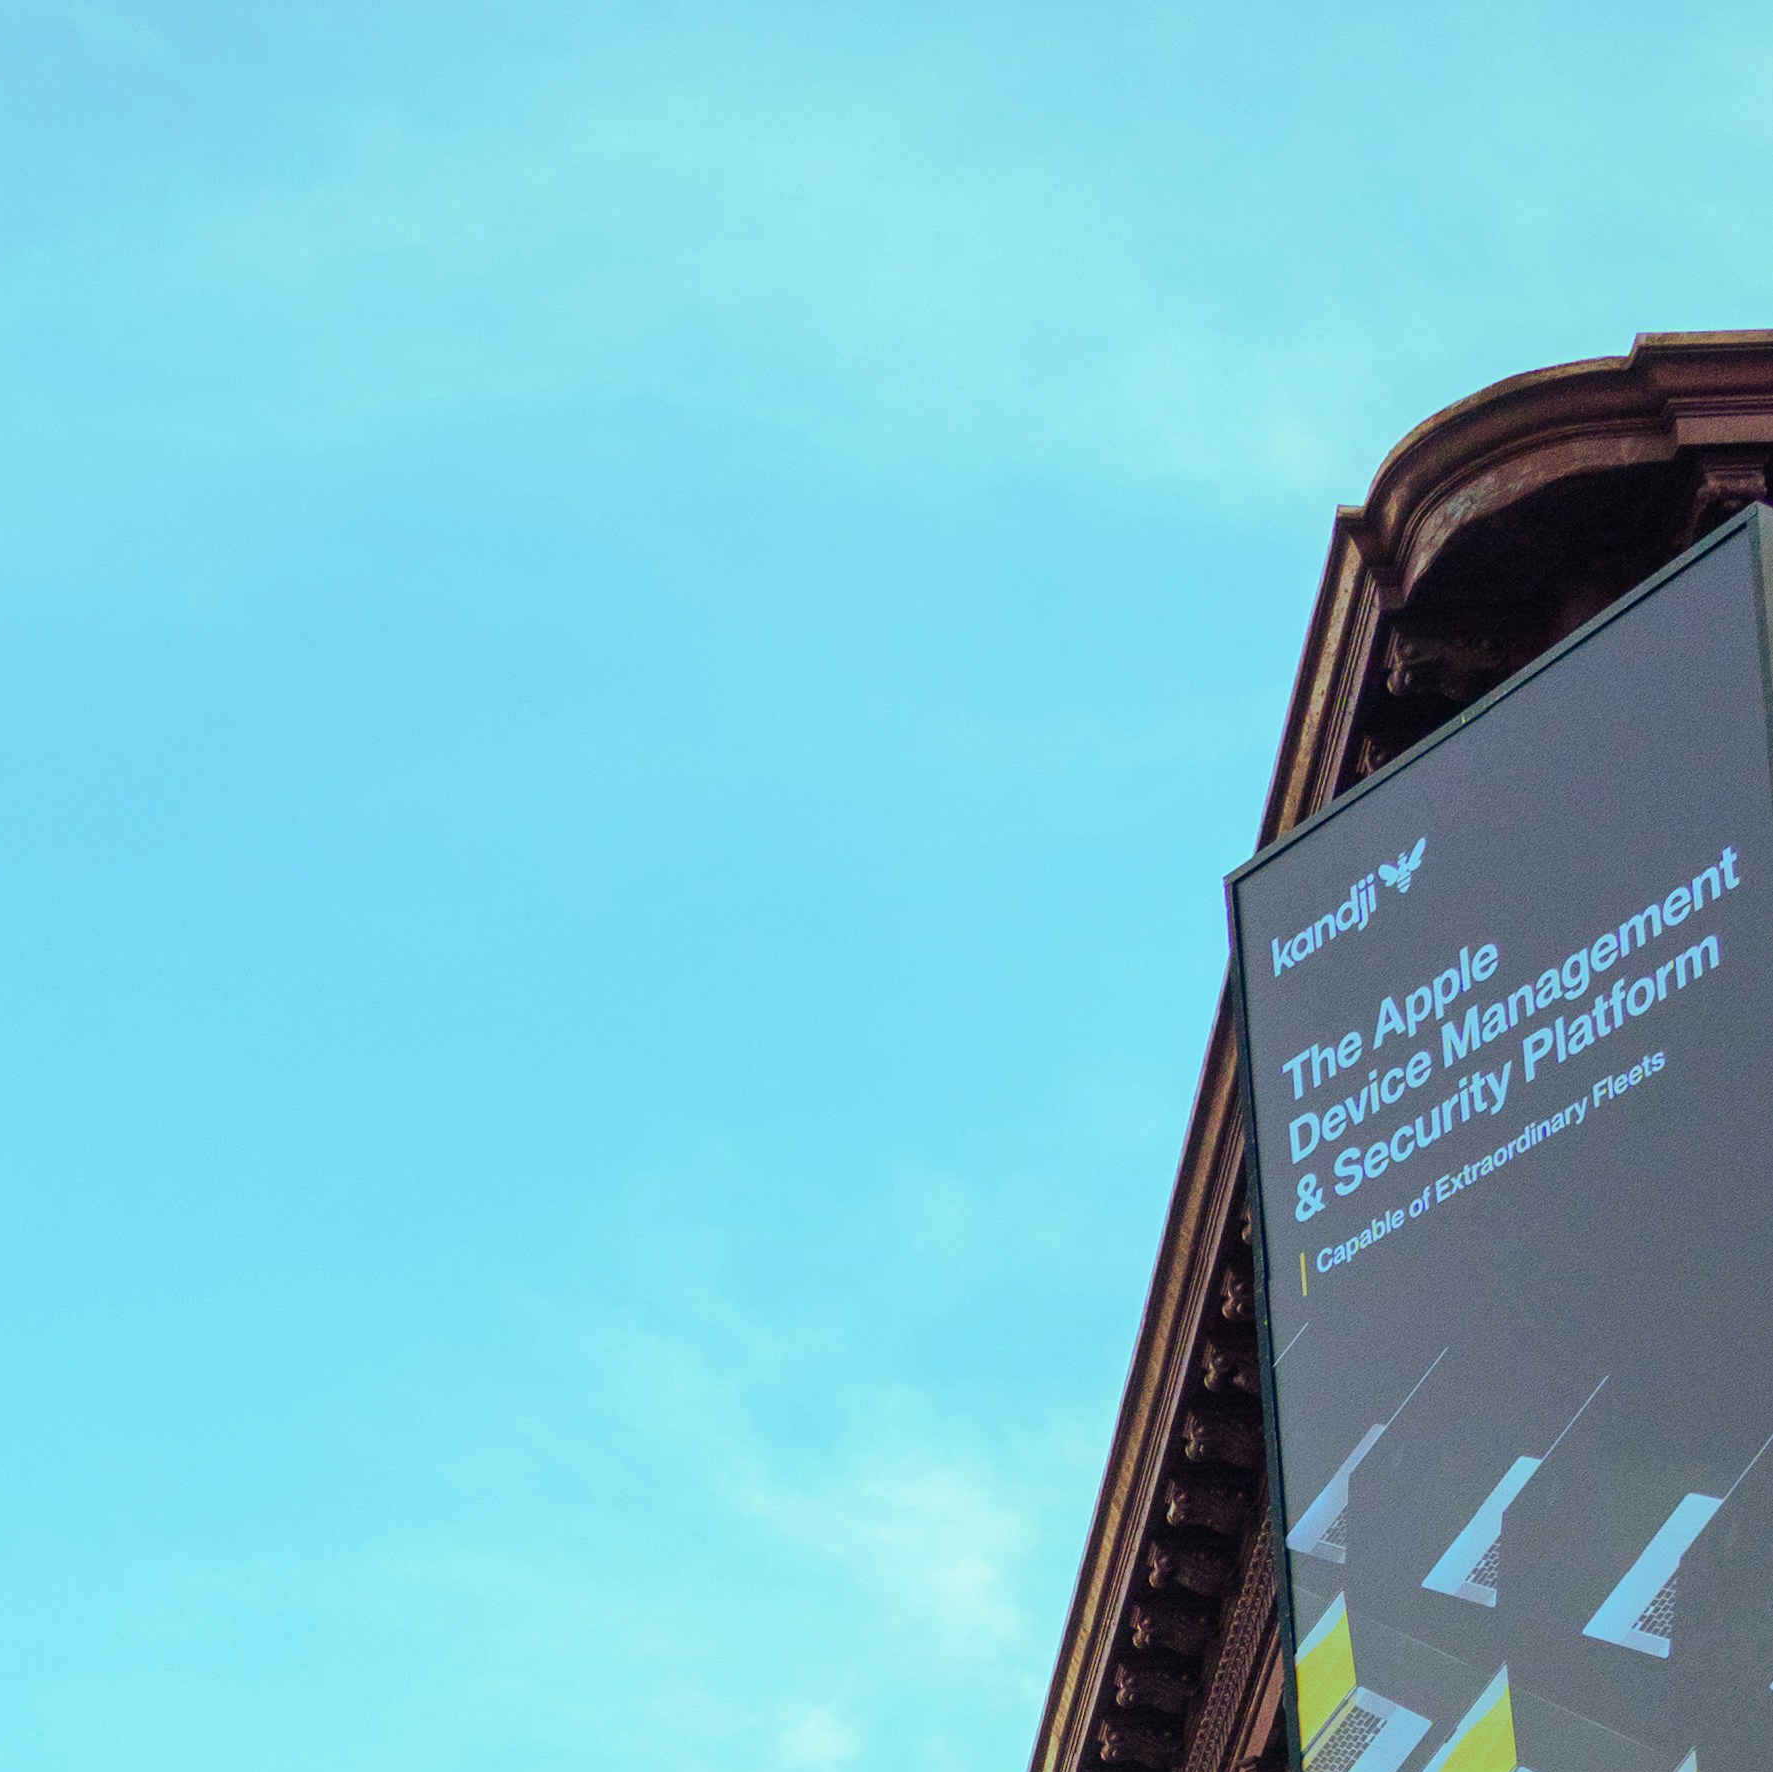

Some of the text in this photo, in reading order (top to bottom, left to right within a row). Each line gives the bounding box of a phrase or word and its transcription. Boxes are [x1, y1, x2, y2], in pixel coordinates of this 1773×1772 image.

[1270, 873, 1377, 977] kandji
[1282, 942, 1499, 1100] The Apple
[1289, 846, 1740, 1164] Device Management
[1294, 934, 1719, 1222] & Security Platform
[1315, 1050, 1667, 1273] Capable of Extraordinary Fleets
